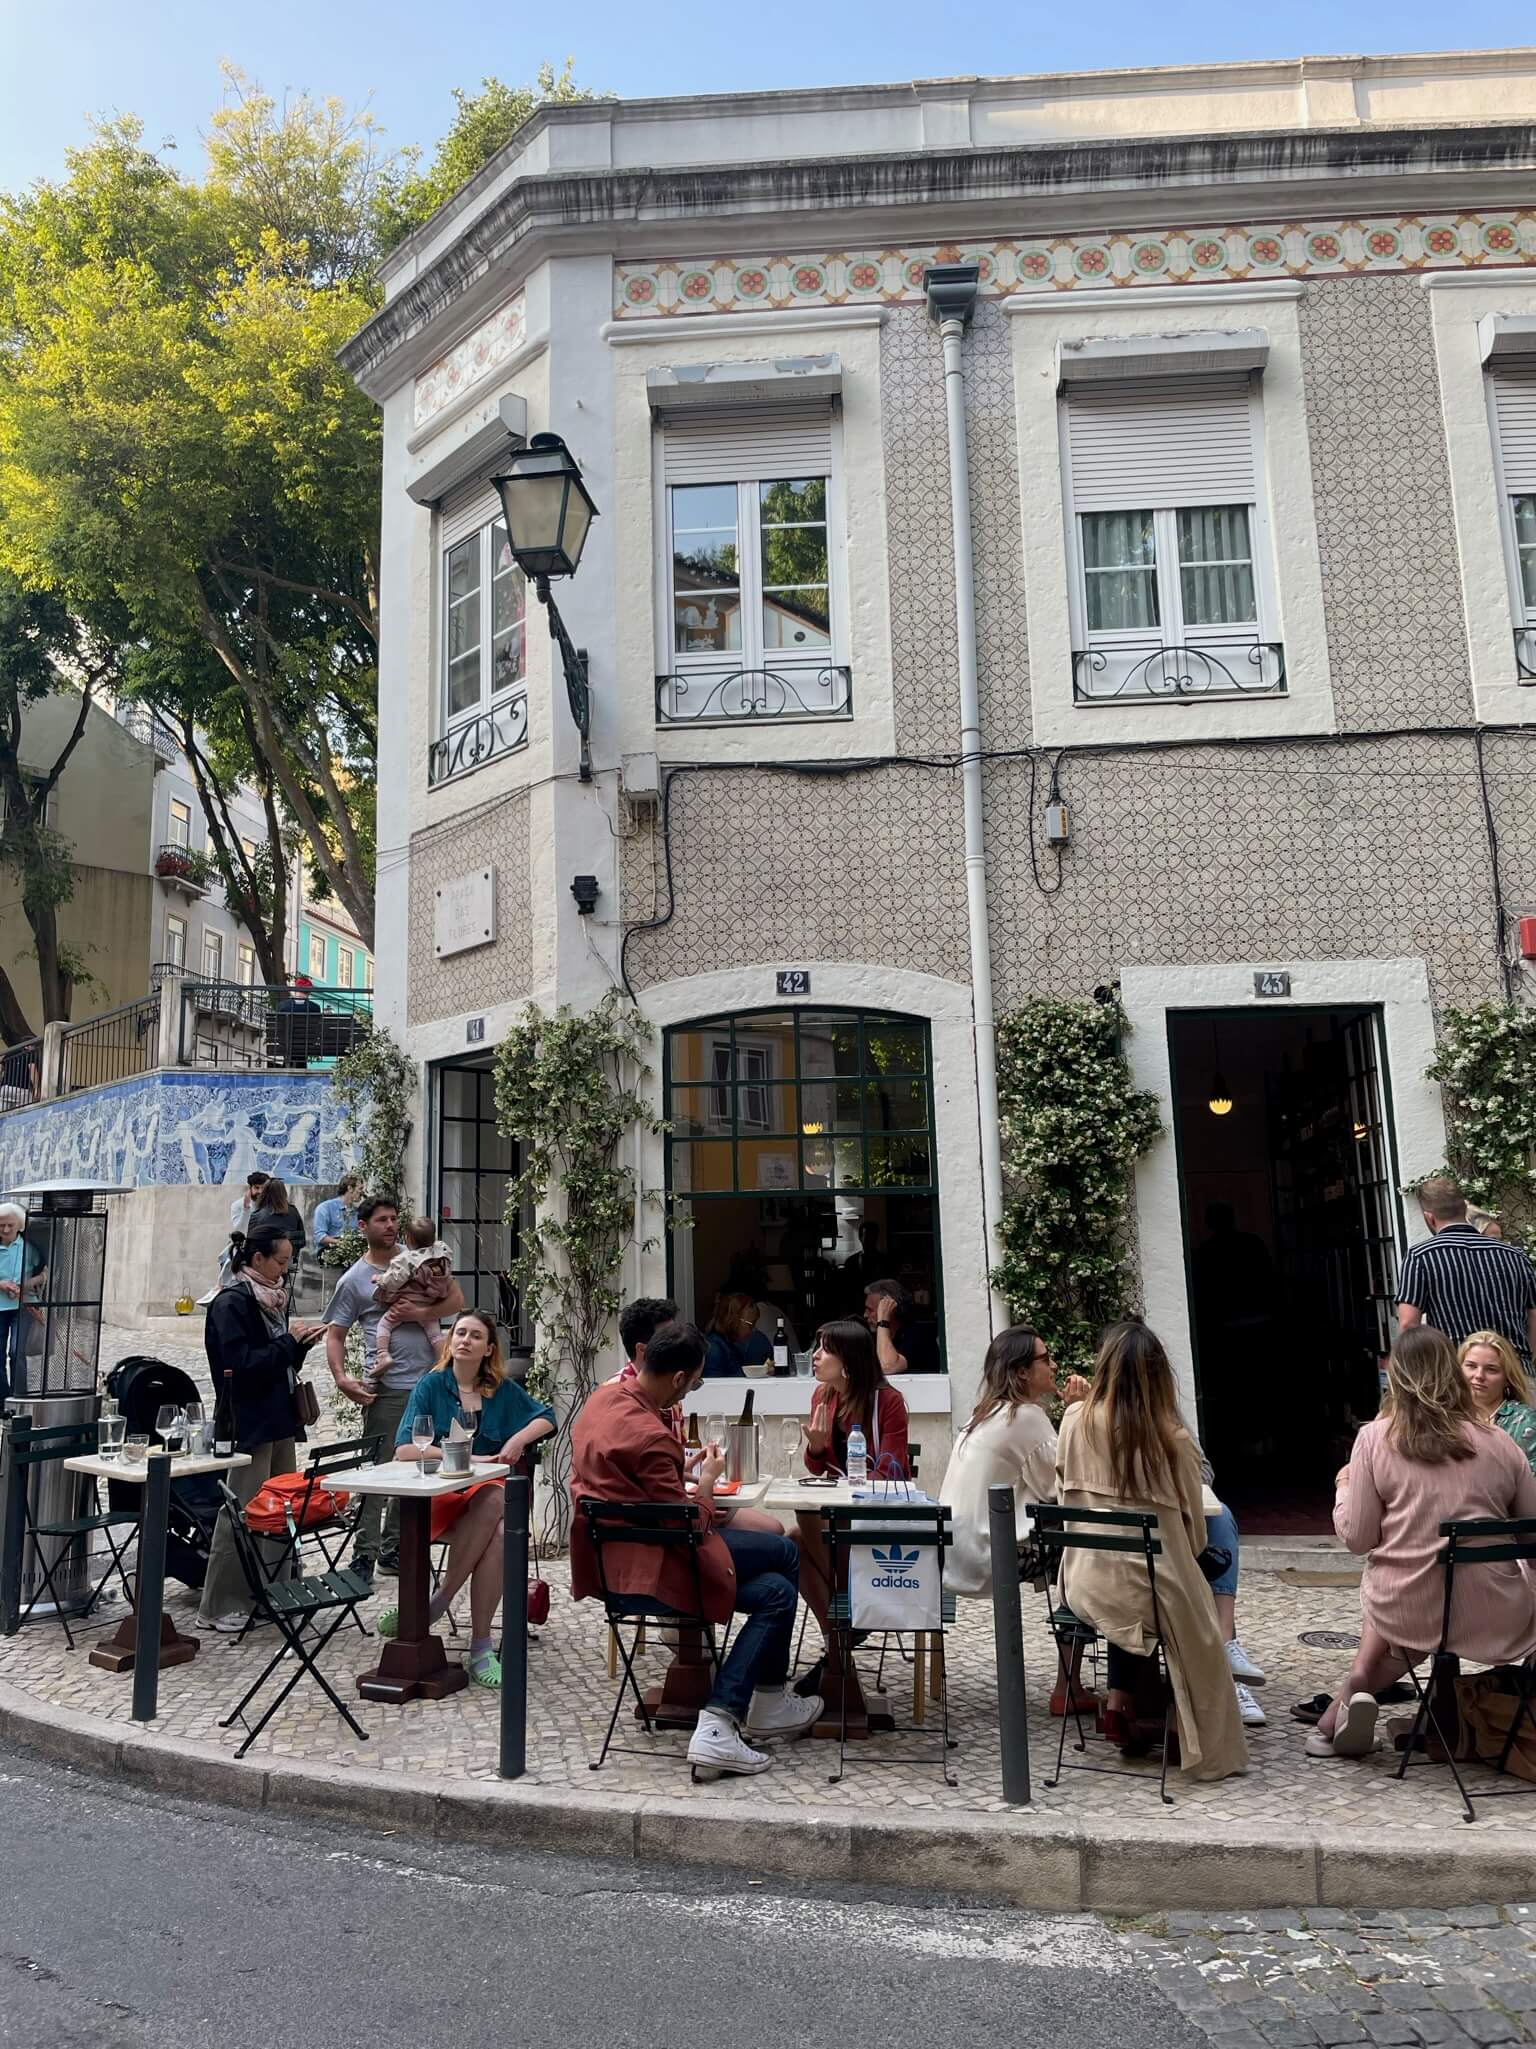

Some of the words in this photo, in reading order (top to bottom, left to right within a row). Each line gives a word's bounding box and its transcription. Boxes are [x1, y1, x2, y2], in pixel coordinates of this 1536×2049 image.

[782, 972, 805, 993] 42
[1261, 973, 1284, 995] 43
[871, 1575, 920, 1589] adidas
